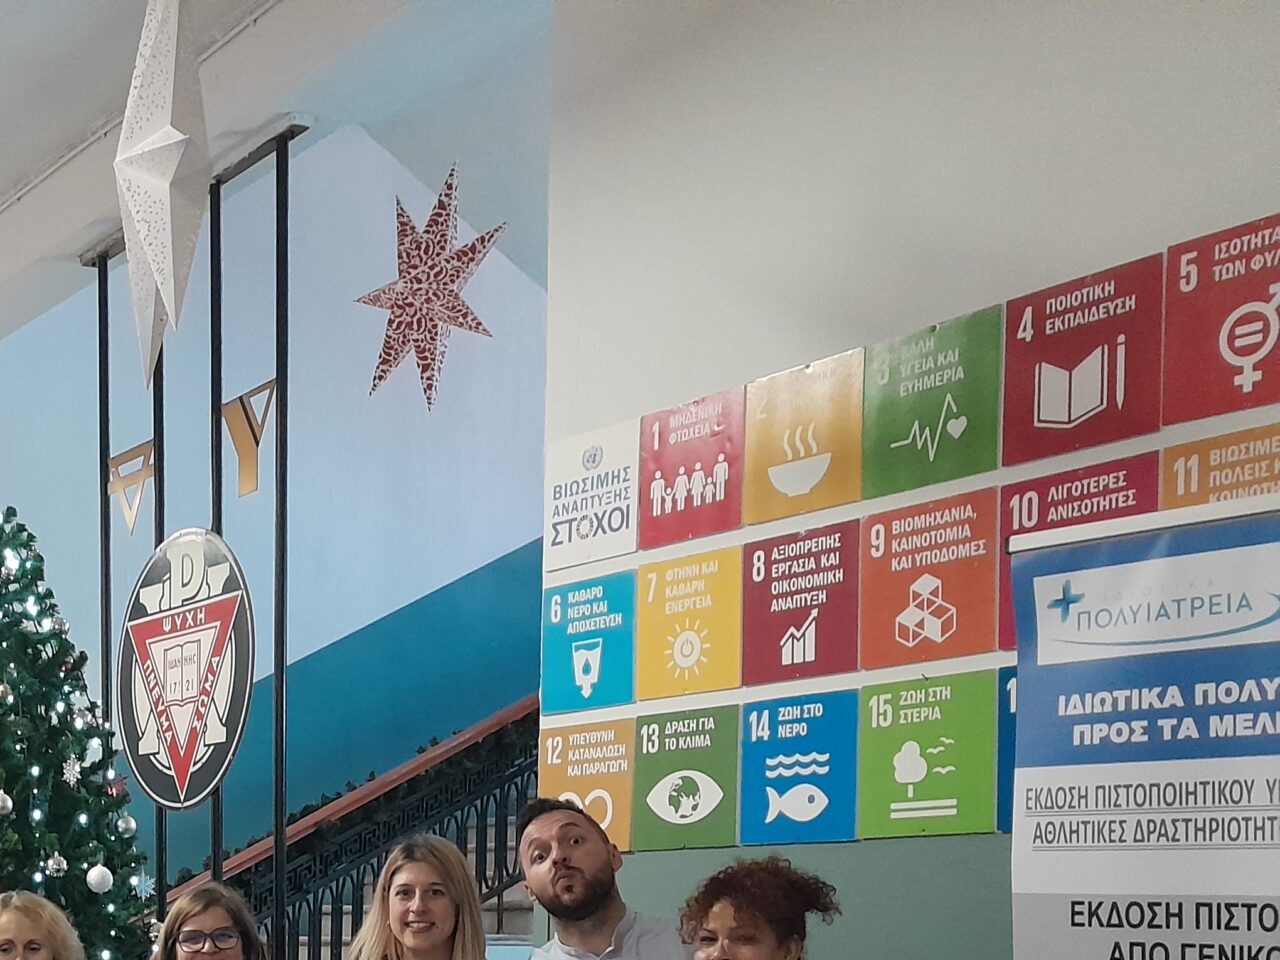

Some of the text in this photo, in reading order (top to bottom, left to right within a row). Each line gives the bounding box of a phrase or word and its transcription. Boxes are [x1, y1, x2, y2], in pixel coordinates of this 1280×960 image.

[1180, 250, 1198, 293] 5
[1213, 258, 1246, 281] ΤΩΝ
[1046, 280, 1115, 314] ΠΟΙΟΤΙΚΗ
[1016, 306, 1034, 342] 4
[1045, 295, 1136, 335] ΕΚΠΑΙΔΕΥΣΗ
[899, 347, 960, 377] ΥΓΕΙΑ ΚΑΙ
[899, 366, 965, 397] ΕΥΗΜΕΡΙΑ
[651, 421, 660, 450] 1
[553, 465, 632, 500] ΒΙΩΣΙΜΗΣ
[1048, 470, 1127, 502] ΛΙΓΟΤΕΡΕΣ
[1174, 454, 1199, 496] 11
[1209, 460, 1270, 488] ΠΟΛΕΙΣ
[552, 487, 631, 519] ΑΝΑΠΤΥΞΗΣ
[1009, 490, 1039, 530] 10
[1047, 489, 1137, 523] ΑΝΙΣΟΤΗΤΕΣ
[551, 506, 631, 547] ΣΤΟΧΟΙ
[892, 503, 977, 535] ΒΙΟΜΗΧΑΝΙΑ,
[771, 532, 841, 561] ΑΞΙΟΠΡΕΠΗΣ
[871, 523, 885, 558] 9
[892, 523, 971, 554] ΚΑΙΝΟΤΟΜΙΑ
[752, 550, 765, 582] 8
[771, 551, 840, 578] ΕΡΓΑΣΙΑ ΚΑΙ
[891, 539, 986, 572] ΚΑΙ ΥΠΟΔΟΜΕΣ
[665, 559, 719, 583] ΦΤΗΝΗ ΚΑΙ
[771, 568, 844, 596] ΟΙΚΟΝΟΜΙΚΗ
[567, 586, 603, 604] ΚΑΘΑΡΟ
[647, 572, 658, 602] 7
[665, 578, 706, 598] ΚΑΘΑΡΗ
[770, 589, 827, 613] ΑΝΑΠΤΥΞΗ
[550, 594, 561, 624] 6
[567, 601, 608, 619] ΝΕΡΟ ΚΑΙ
[665, 594, 712, 614] ΕΝΕΡΓΕΙΑ
[1076, 591, 1253, 631] ΠΟΛΥΙΑΤΡΕΙΑ
[162, 607, 206, 632] ΨΥΧΗ
[566, 613, 622, 635] ΑΠΟΧΕΤΕΥΣΗ
[143, 659, 173, 746] ΠΝΕΥΜΑ
[778, 702, 823, 720] ΖΩΗ ΣΤΟ
[869, 695, 893, 728] 15
[899, 686, 951, 707] ΖΩΗ ΣΤΗ
[1058, 685, 1184, 716] ΙΔΙΩΤΙΚΑ
[664, 716, 715, 736] ΔΡΑΣΗ ΓΙΑ
[749, 710, 770, 742] 14
[778, 722, 807, 739] ΝΕΡΟ
[899, 707, 941, 726] ΣΤΕΡΙΑ
[1073, 710, 1280, 746] ΠΡΟΣ ΤΑ ΜΕΛ
[545, 735, 562, 766] 12
[568, 729, 615, 748] ΥΠΕΥΘΥΝΗ
[568, 743, 626, 762] ΚΑΤΑΝΑΛΩΣΗ
[640, 724, 659, 754] 13
[665, 734, 711, 751] ΤΟ ΚΛΙΜΑ
[567, 758, 628, 776] ΚΑΙ ΠΑΡΑΓΩΓΗ
[1025, 786, 1088, 811] ΕΚΔΟΣΗ
[1095, 779, 1255, 810] ΠΙΣΤΟΠΟΙΗΤΙΚΟΥ
[1032, 819, 1127, 845] ΑΘΛΗΤΙΚΕΣ
[1070, 900, 1280, 932] ΕΚΔΟΣΗ ΠΙΣΤΟ
